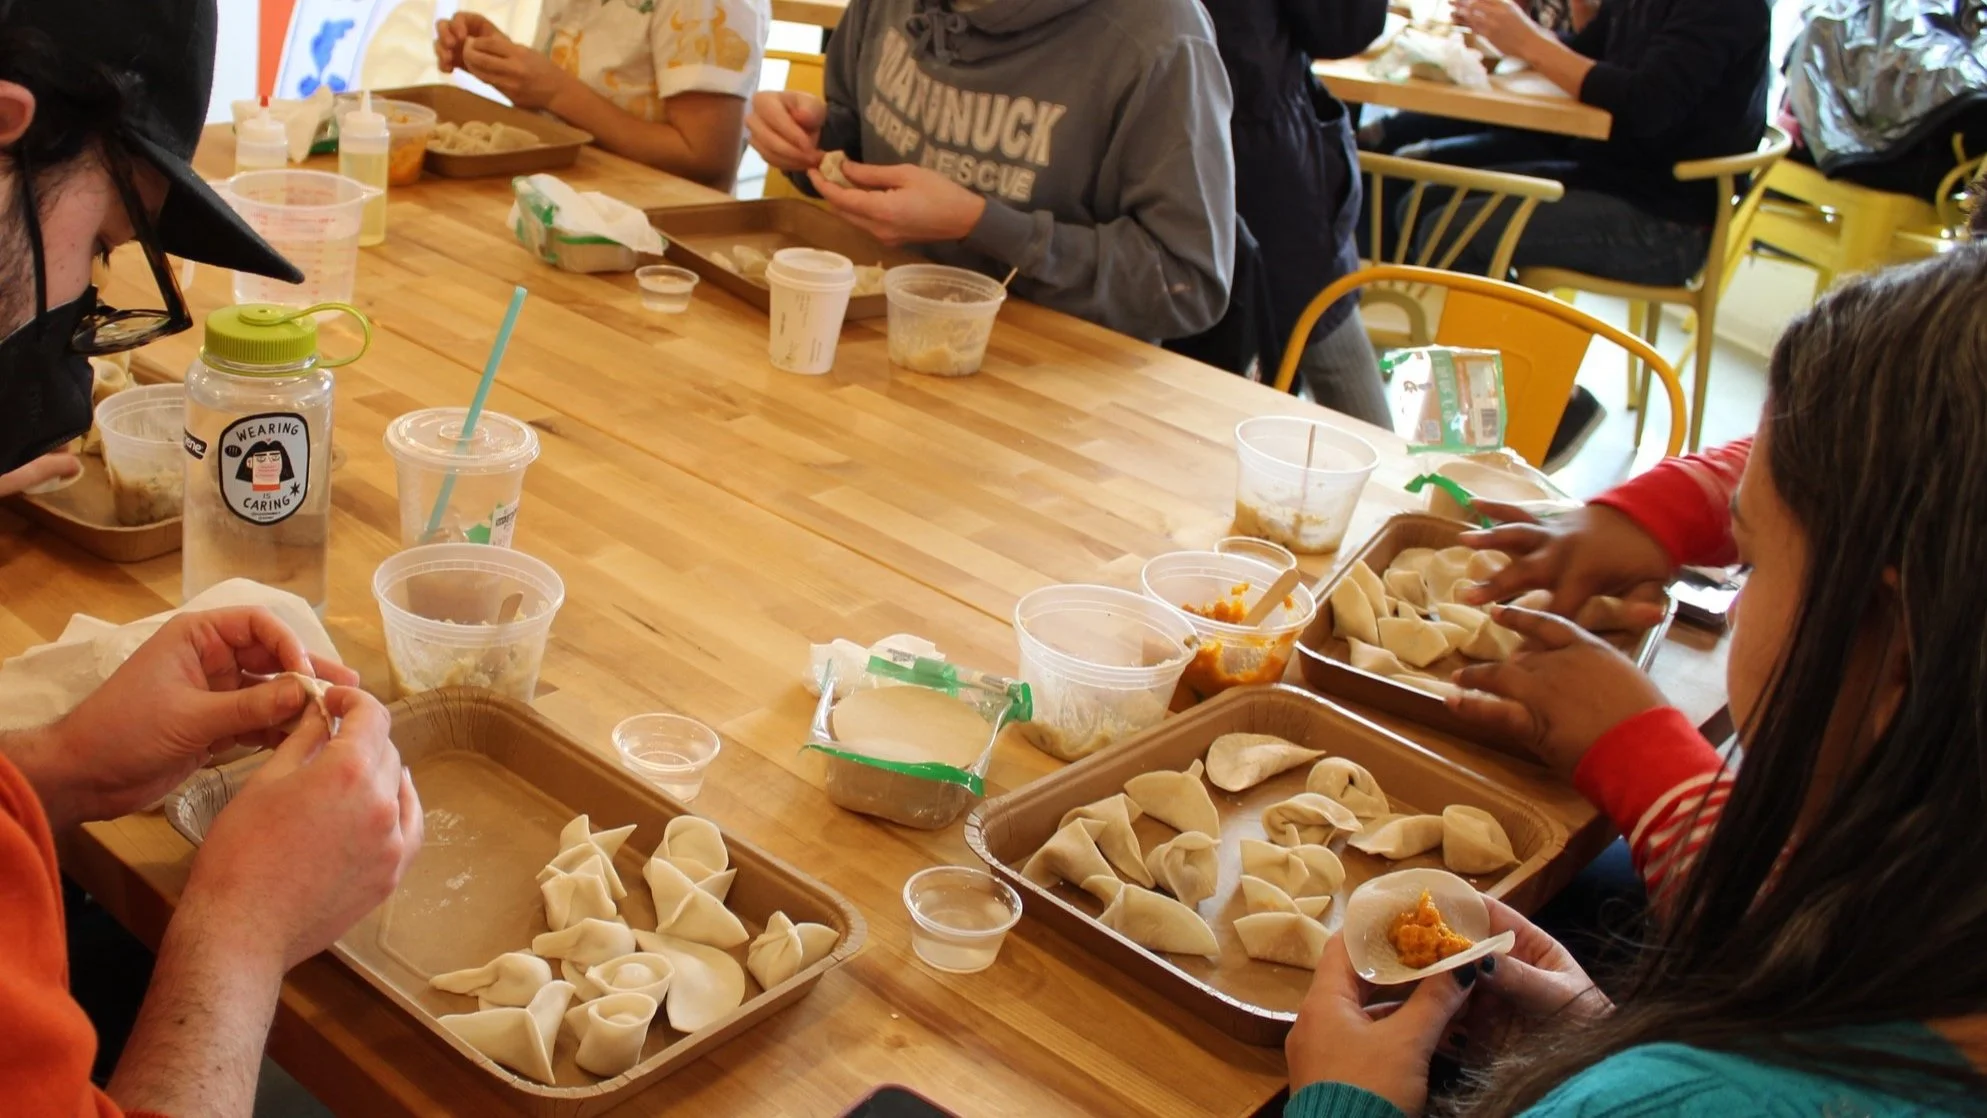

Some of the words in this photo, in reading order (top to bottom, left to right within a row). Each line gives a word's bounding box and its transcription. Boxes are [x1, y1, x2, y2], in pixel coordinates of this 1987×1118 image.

[236, 423, 299, 442] WEARING
[185, 436, 205, 456] ene
[243, 495, 290, 511] CARING
